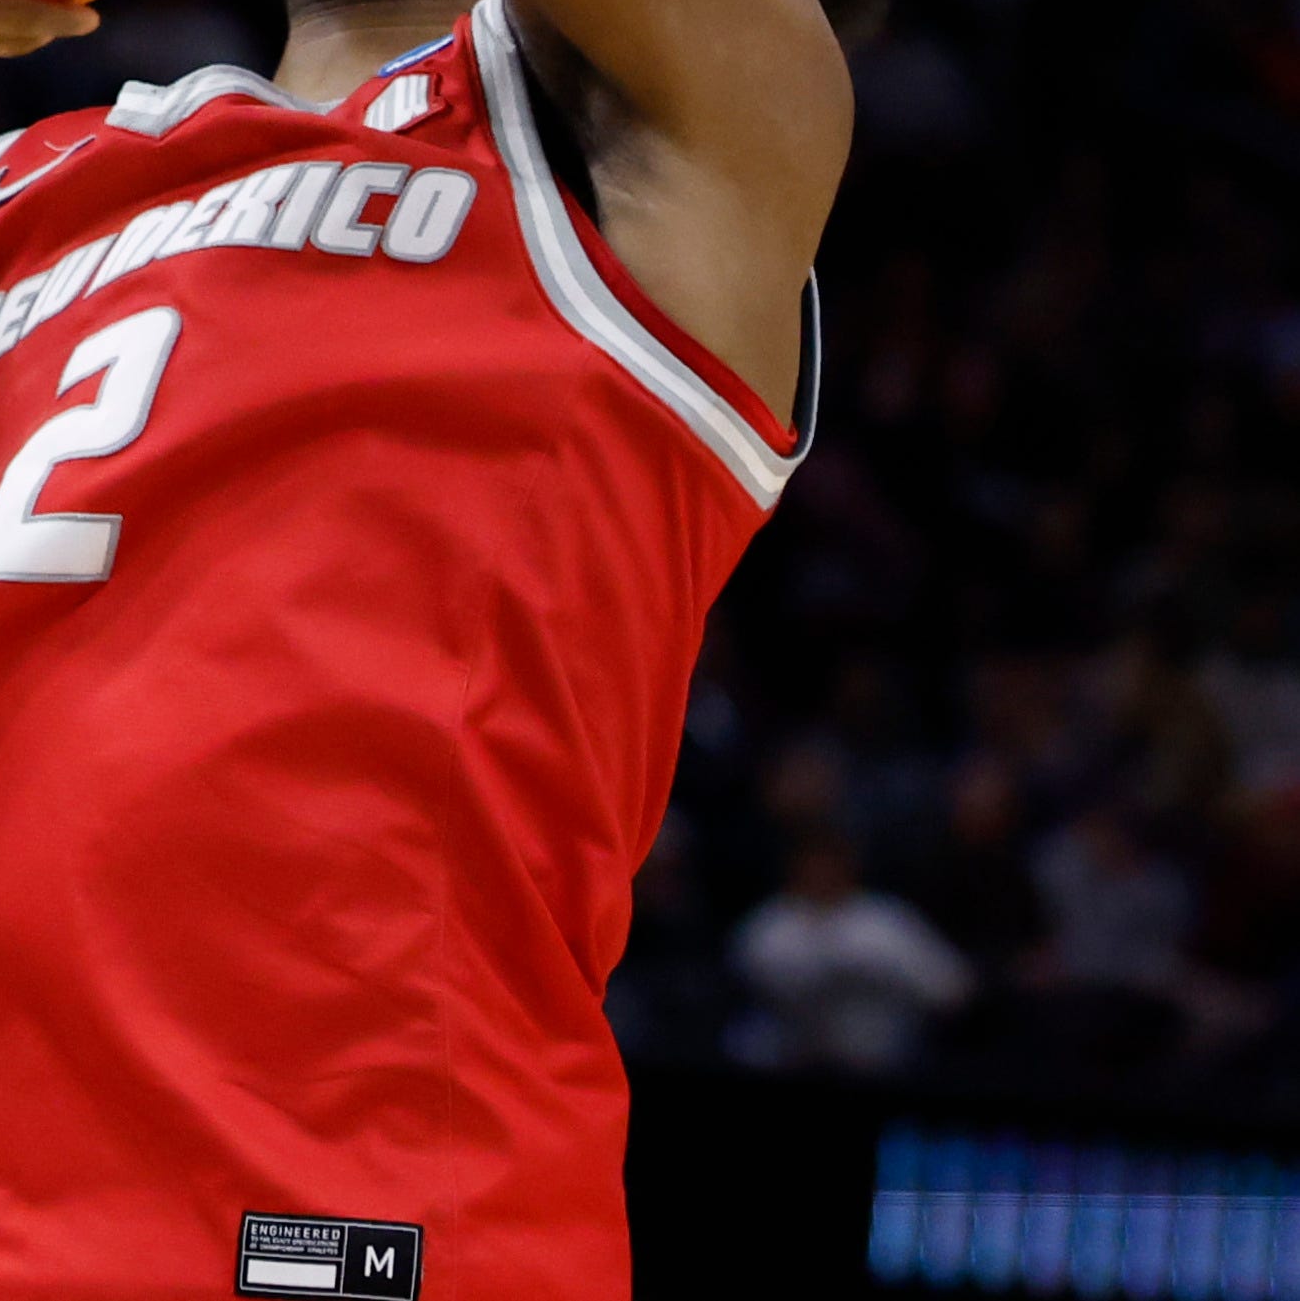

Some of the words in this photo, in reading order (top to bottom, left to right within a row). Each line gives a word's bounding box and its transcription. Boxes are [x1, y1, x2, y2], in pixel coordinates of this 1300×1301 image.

[82, 161, 478, 264] MEXICO
[250, 1223, 341, 1240] ENGINEERED
[364, 1244, 395, 1280] M
